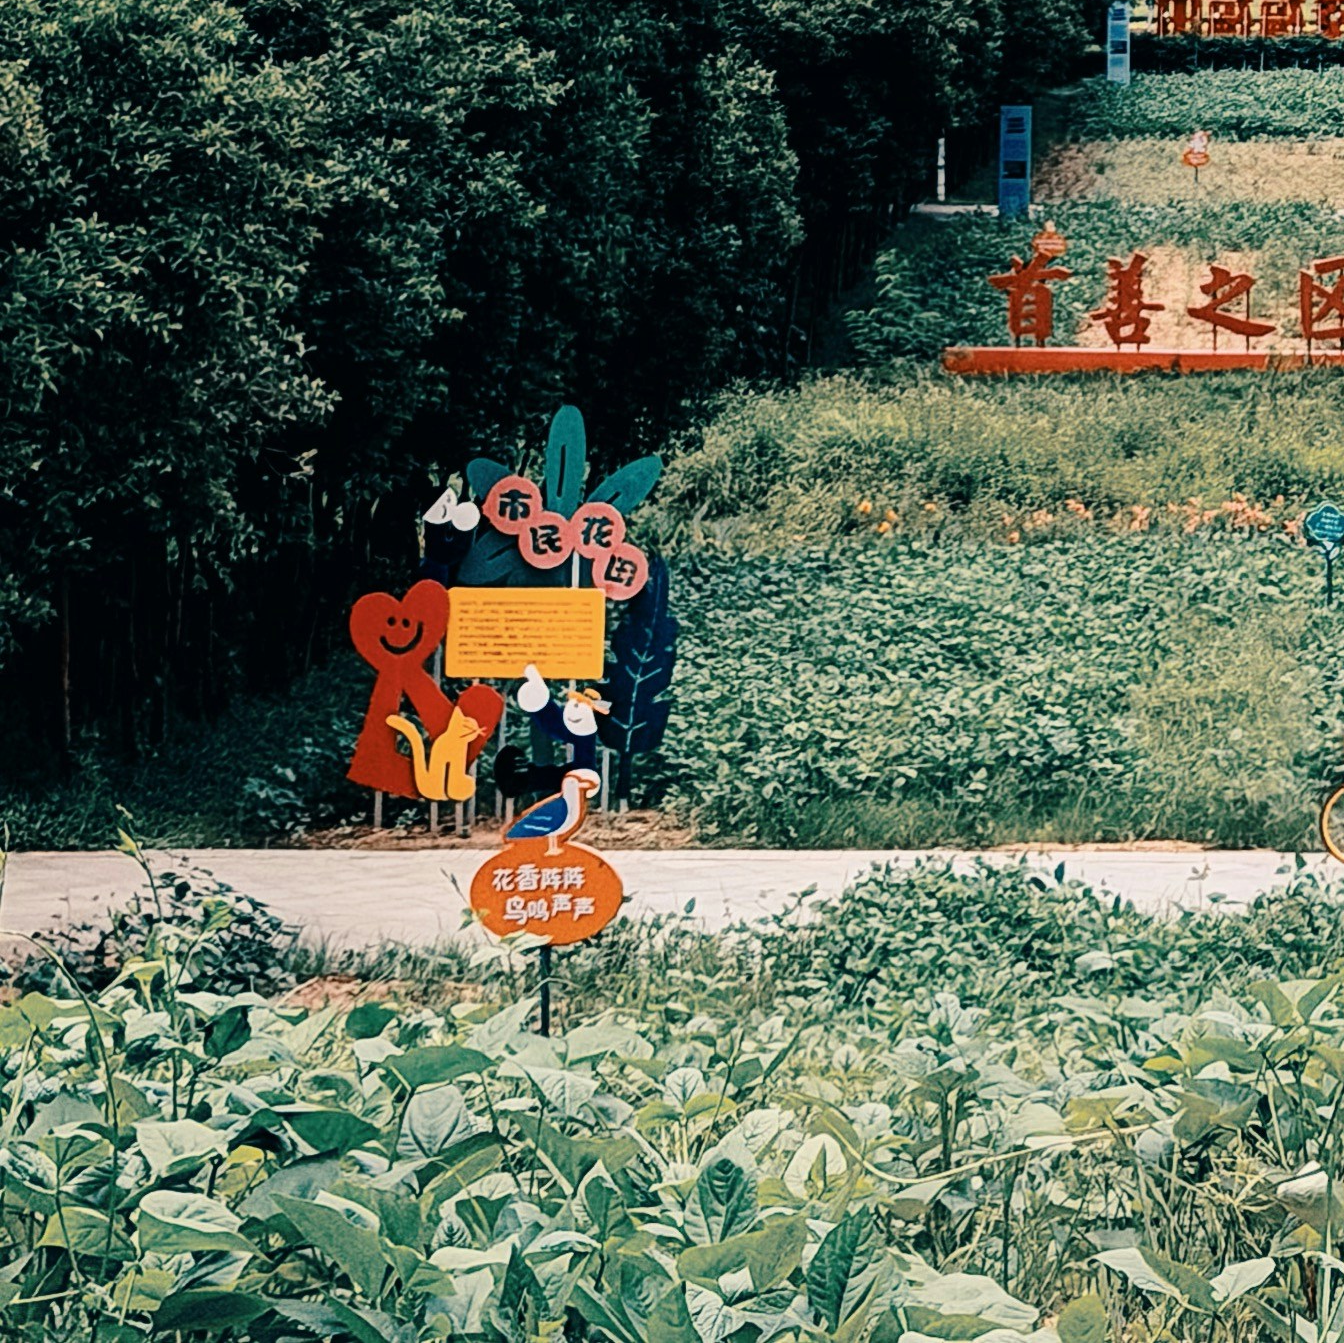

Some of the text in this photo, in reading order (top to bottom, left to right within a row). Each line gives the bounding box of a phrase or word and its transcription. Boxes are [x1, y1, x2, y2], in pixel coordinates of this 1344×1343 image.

[498, 489, 637, 587] 市民花田
[491, 863, 585, 891] 花香阵阵
[502, 893, 595, 925] 鸟鸣声声
